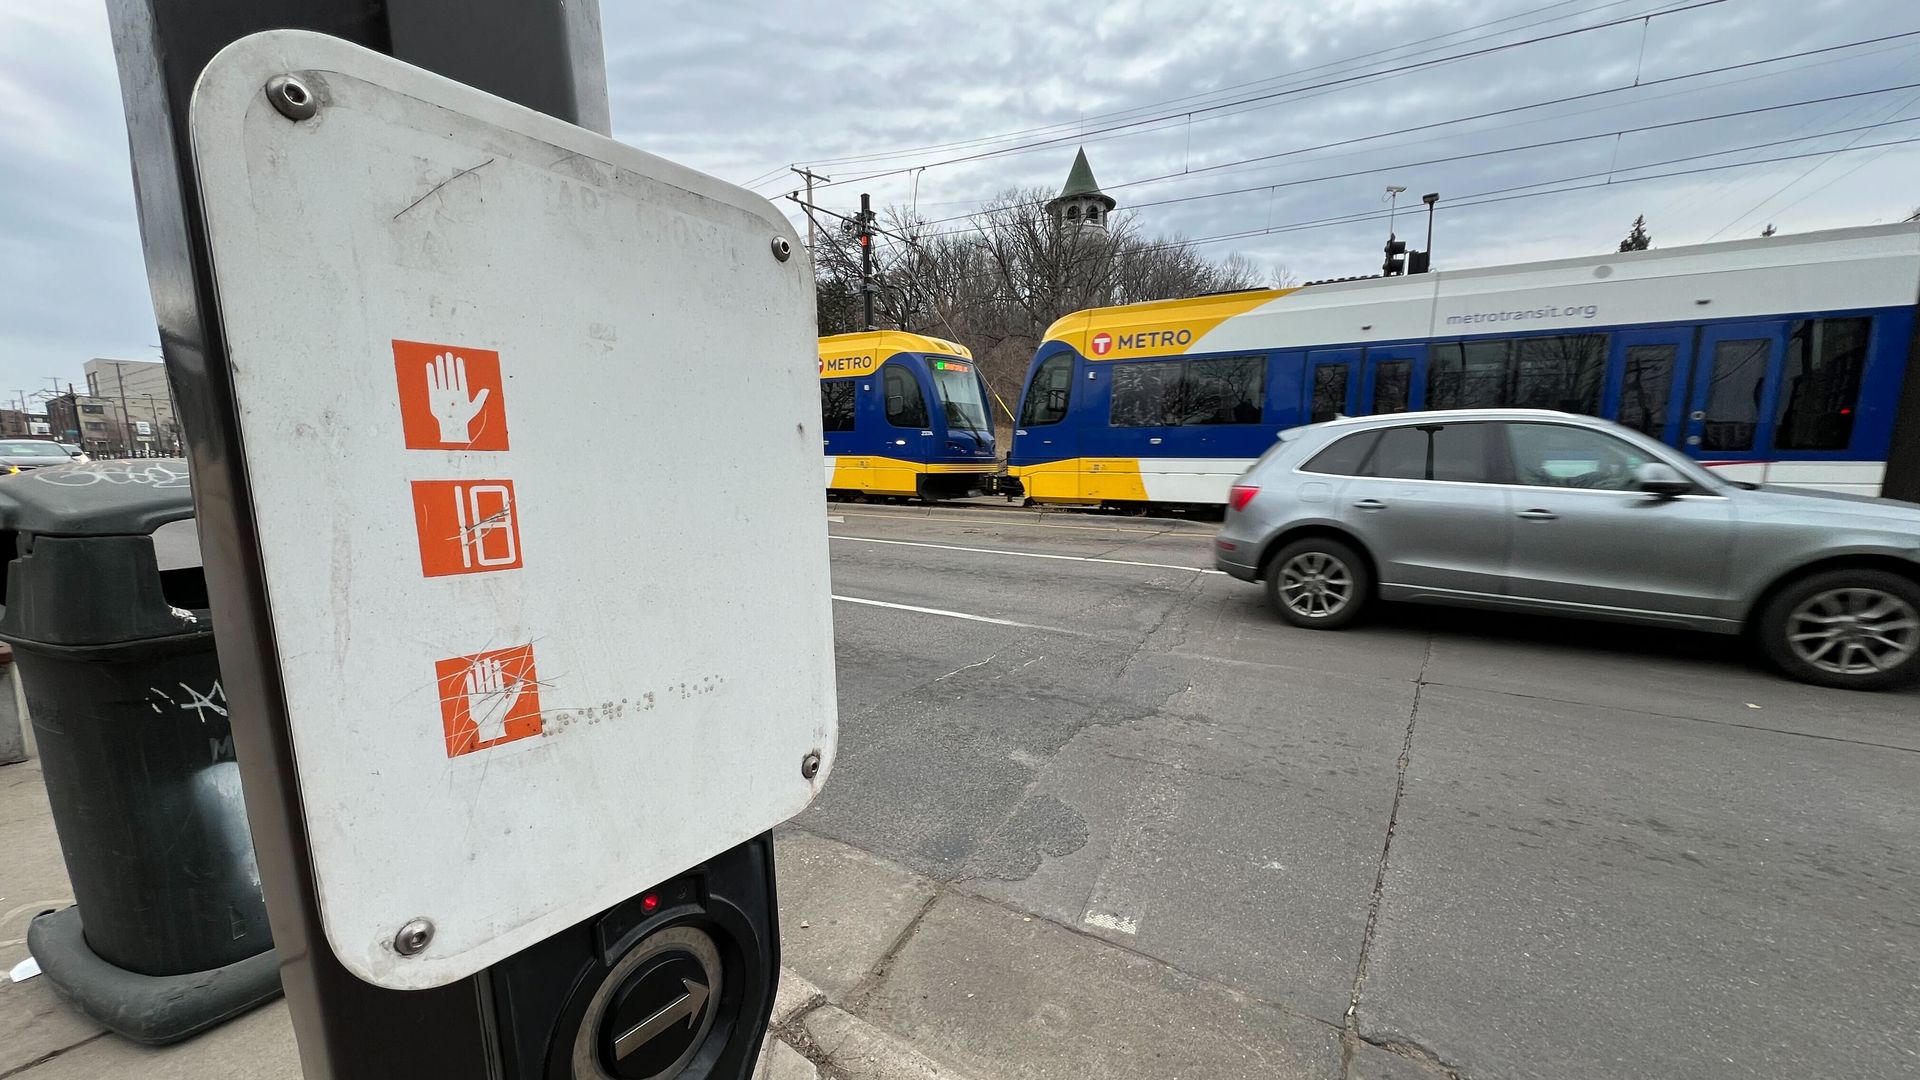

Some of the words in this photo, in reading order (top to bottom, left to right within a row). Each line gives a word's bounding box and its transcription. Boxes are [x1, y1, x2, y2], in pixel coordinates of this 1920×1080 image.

[1446, 304, 1598, 325] metrotransit.org
[1117, 329, 1192, 350] METRO
[827, 355, 872, 371] METRO
[454, 485, 517, 568] 18
